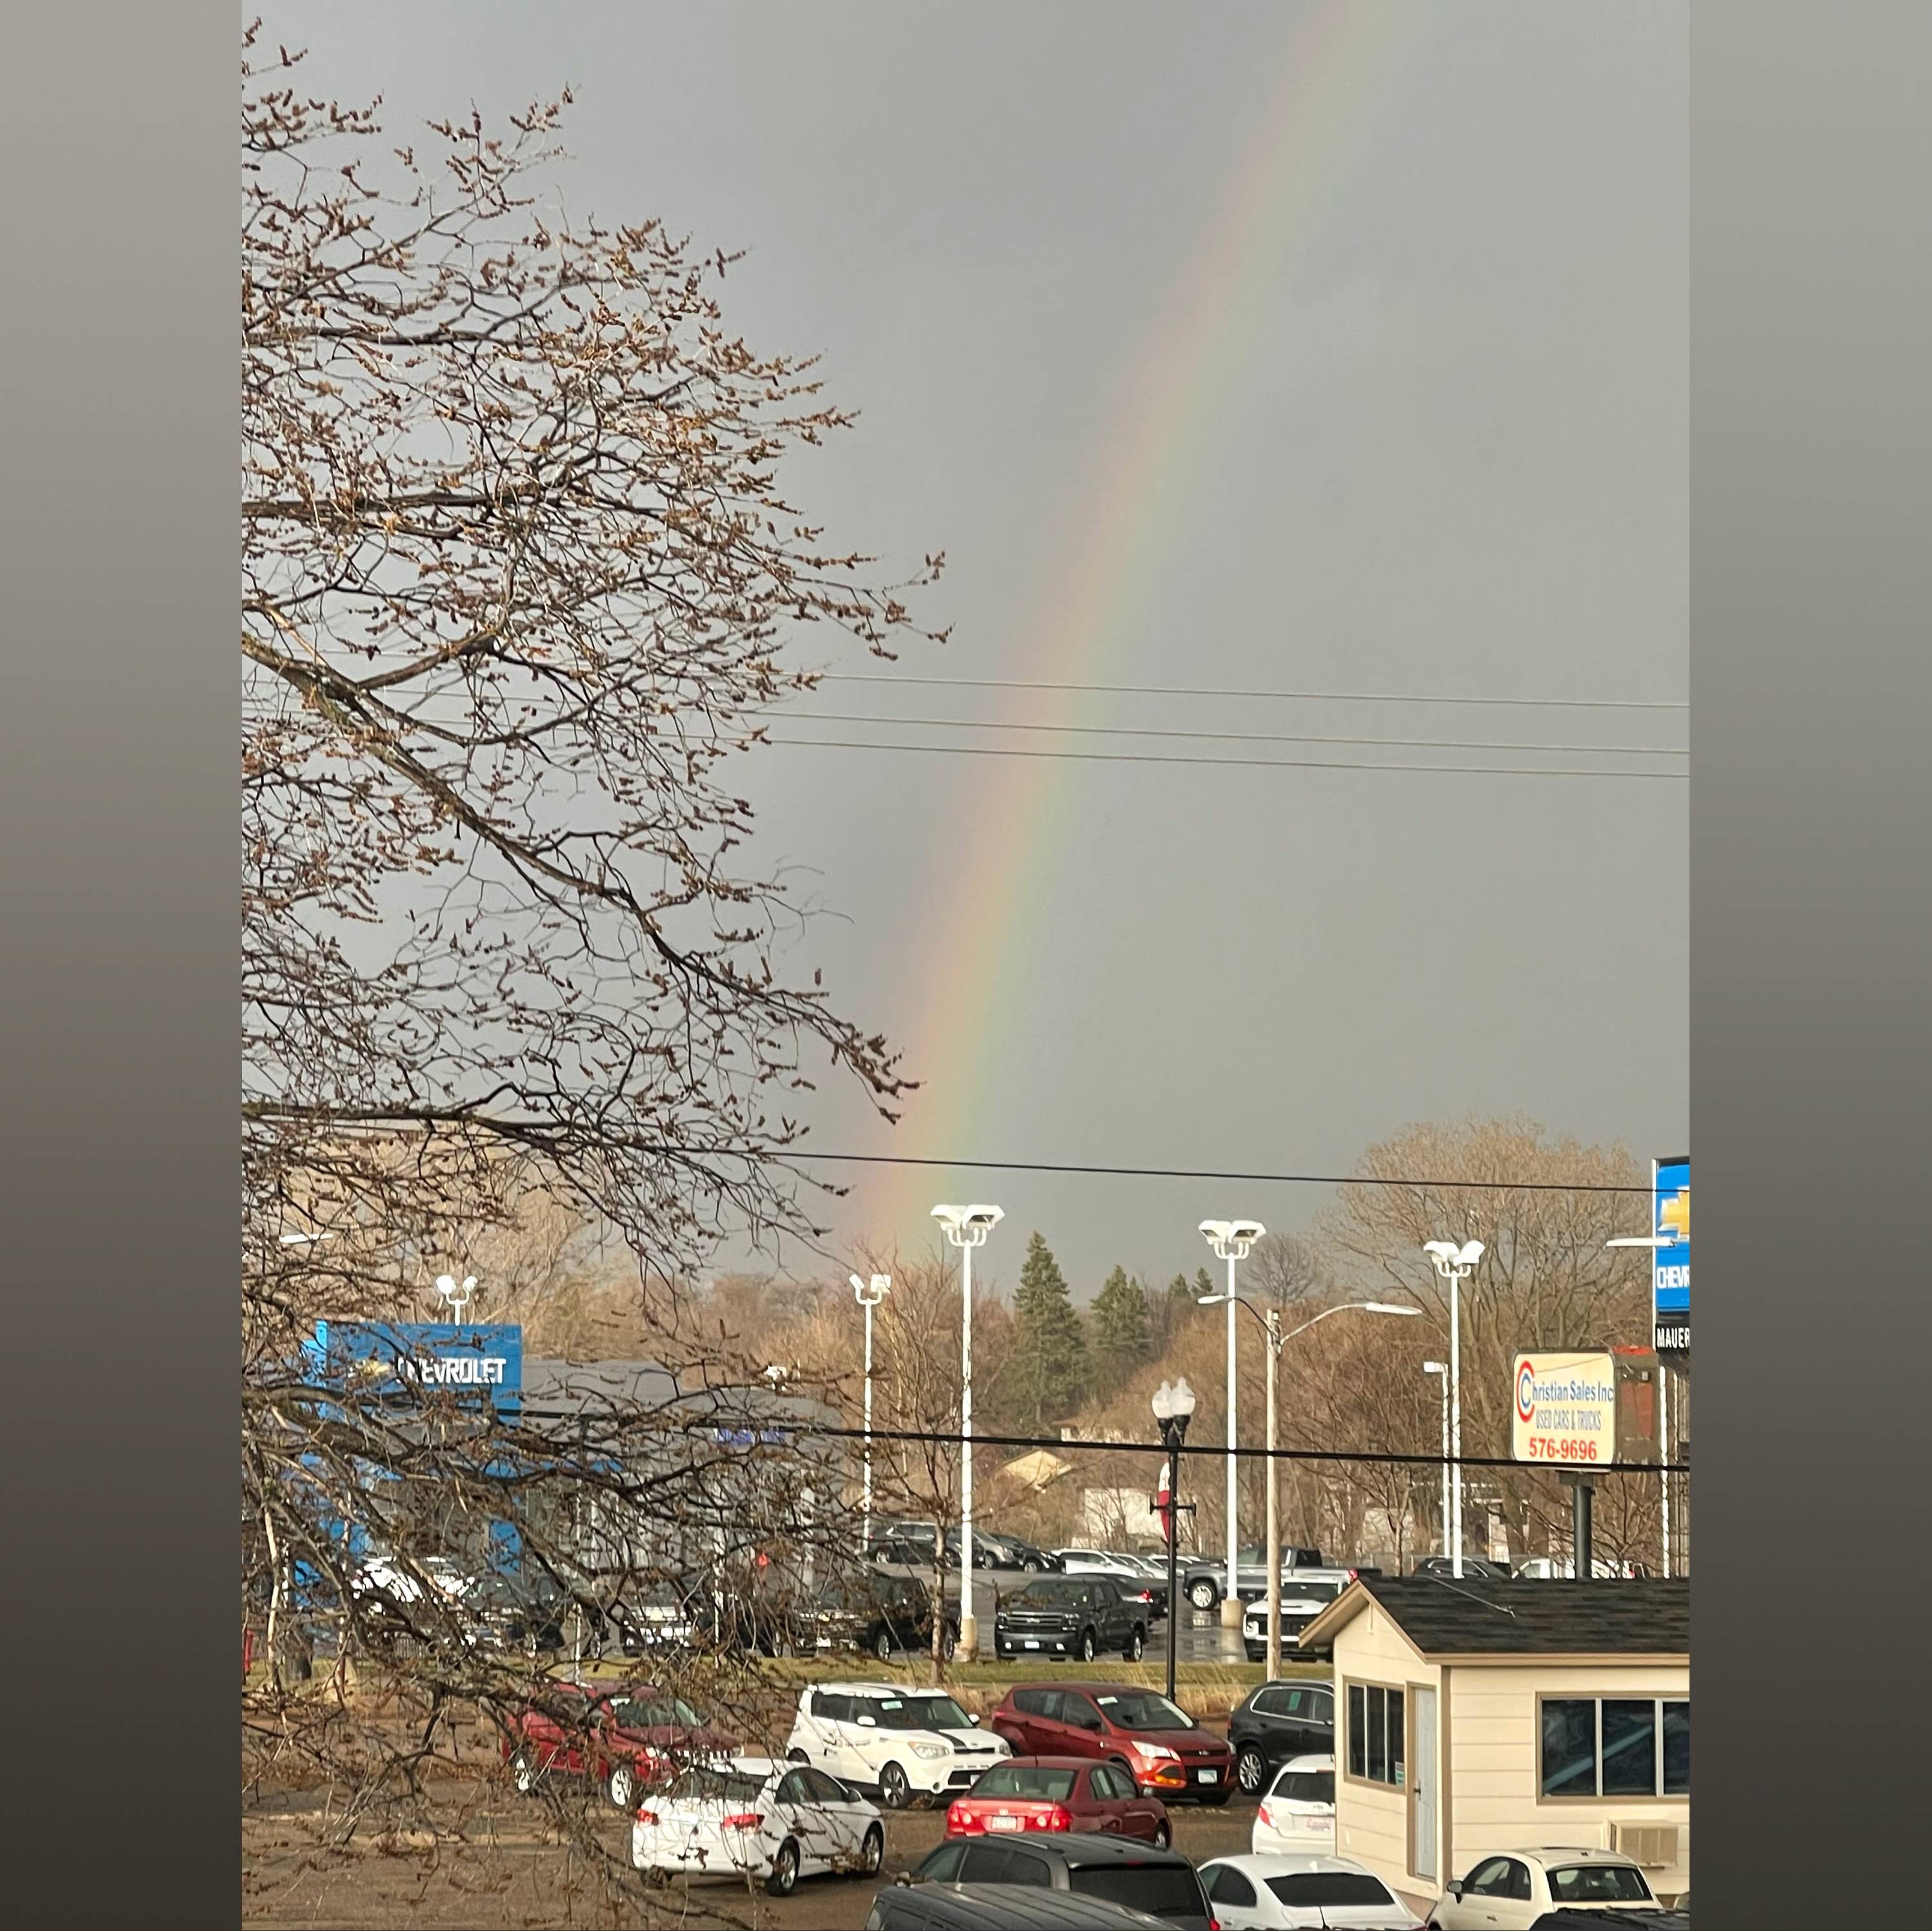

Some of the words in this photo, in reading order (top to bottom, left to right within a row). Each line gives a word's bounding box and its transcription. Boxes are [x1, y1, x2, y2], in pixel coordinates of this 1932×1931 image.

[1520, 1372, 1569, 1409] Christian
[1569, 1380, 1596, 1401] Sales
[1598, 1381, 1614, 1402] Inc
[1536, 1409, 1552, 1430] USED
[1553, 1410, 1569, 1430] CARS
[1571, 1410, 1576, 1430] &
[1577, 1410, 1602, 1431] TRUCKS
[1529, 1436, 1597, 1461] 576-9696
